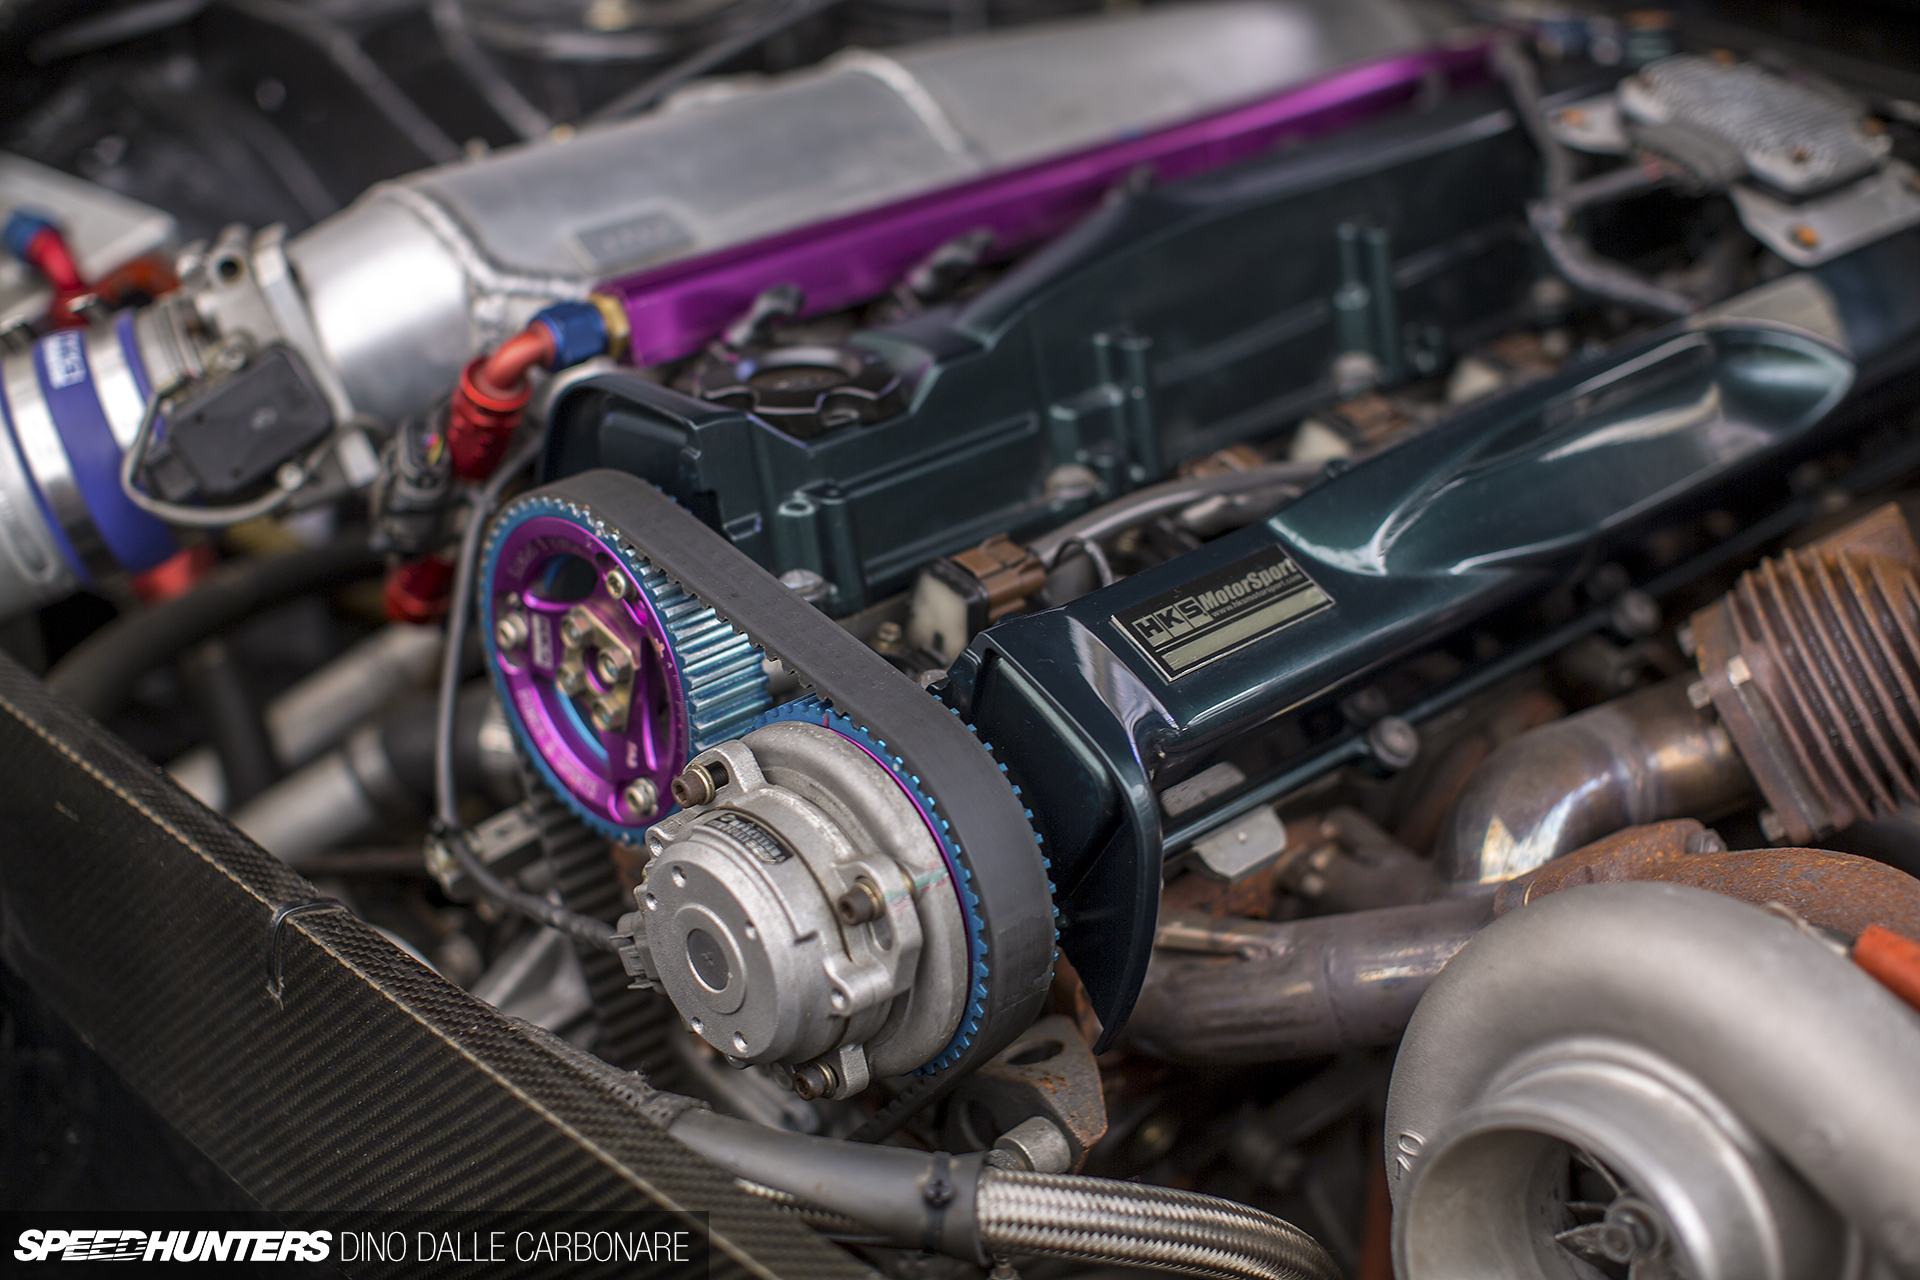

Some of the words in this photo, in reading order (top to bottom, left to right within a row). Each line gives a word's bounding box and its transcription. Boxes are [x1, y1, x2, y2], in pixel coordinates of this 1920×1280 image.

[1133, 598, 1211, 644] HKS
[1197, 557, 1298, 612] MotorSport
[1210, 572, 1303, 618] www.hksmotorsport.com
